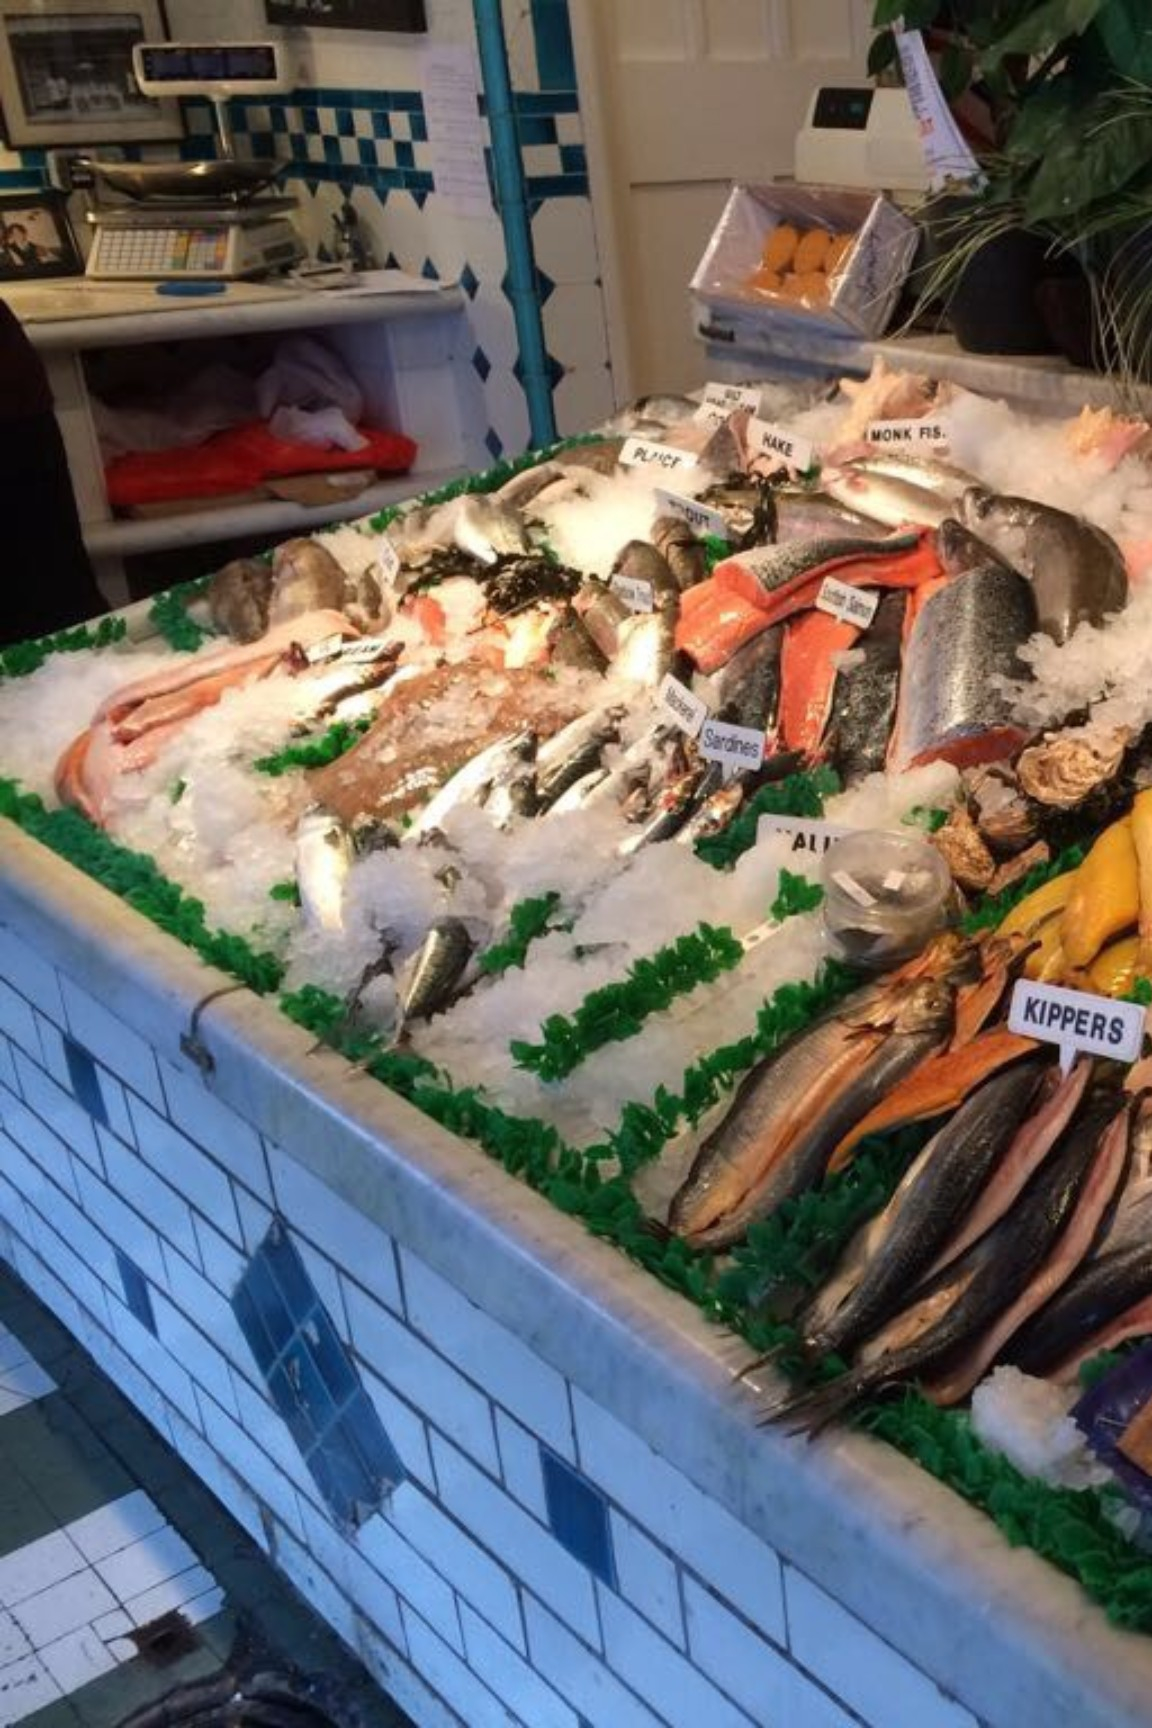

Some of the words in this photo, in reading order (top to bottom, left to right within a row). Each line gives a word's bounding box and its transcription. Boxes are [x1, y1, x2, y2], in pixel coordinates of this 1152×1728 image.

[761, 431, 794, 458] HAKE
[871, 427, 912, 442] MONK
[920, 424, 946, 439] FIS
[703, 728, 760, 759] Sardines
[1022, 996, 1125, 1045] KIPPERS
